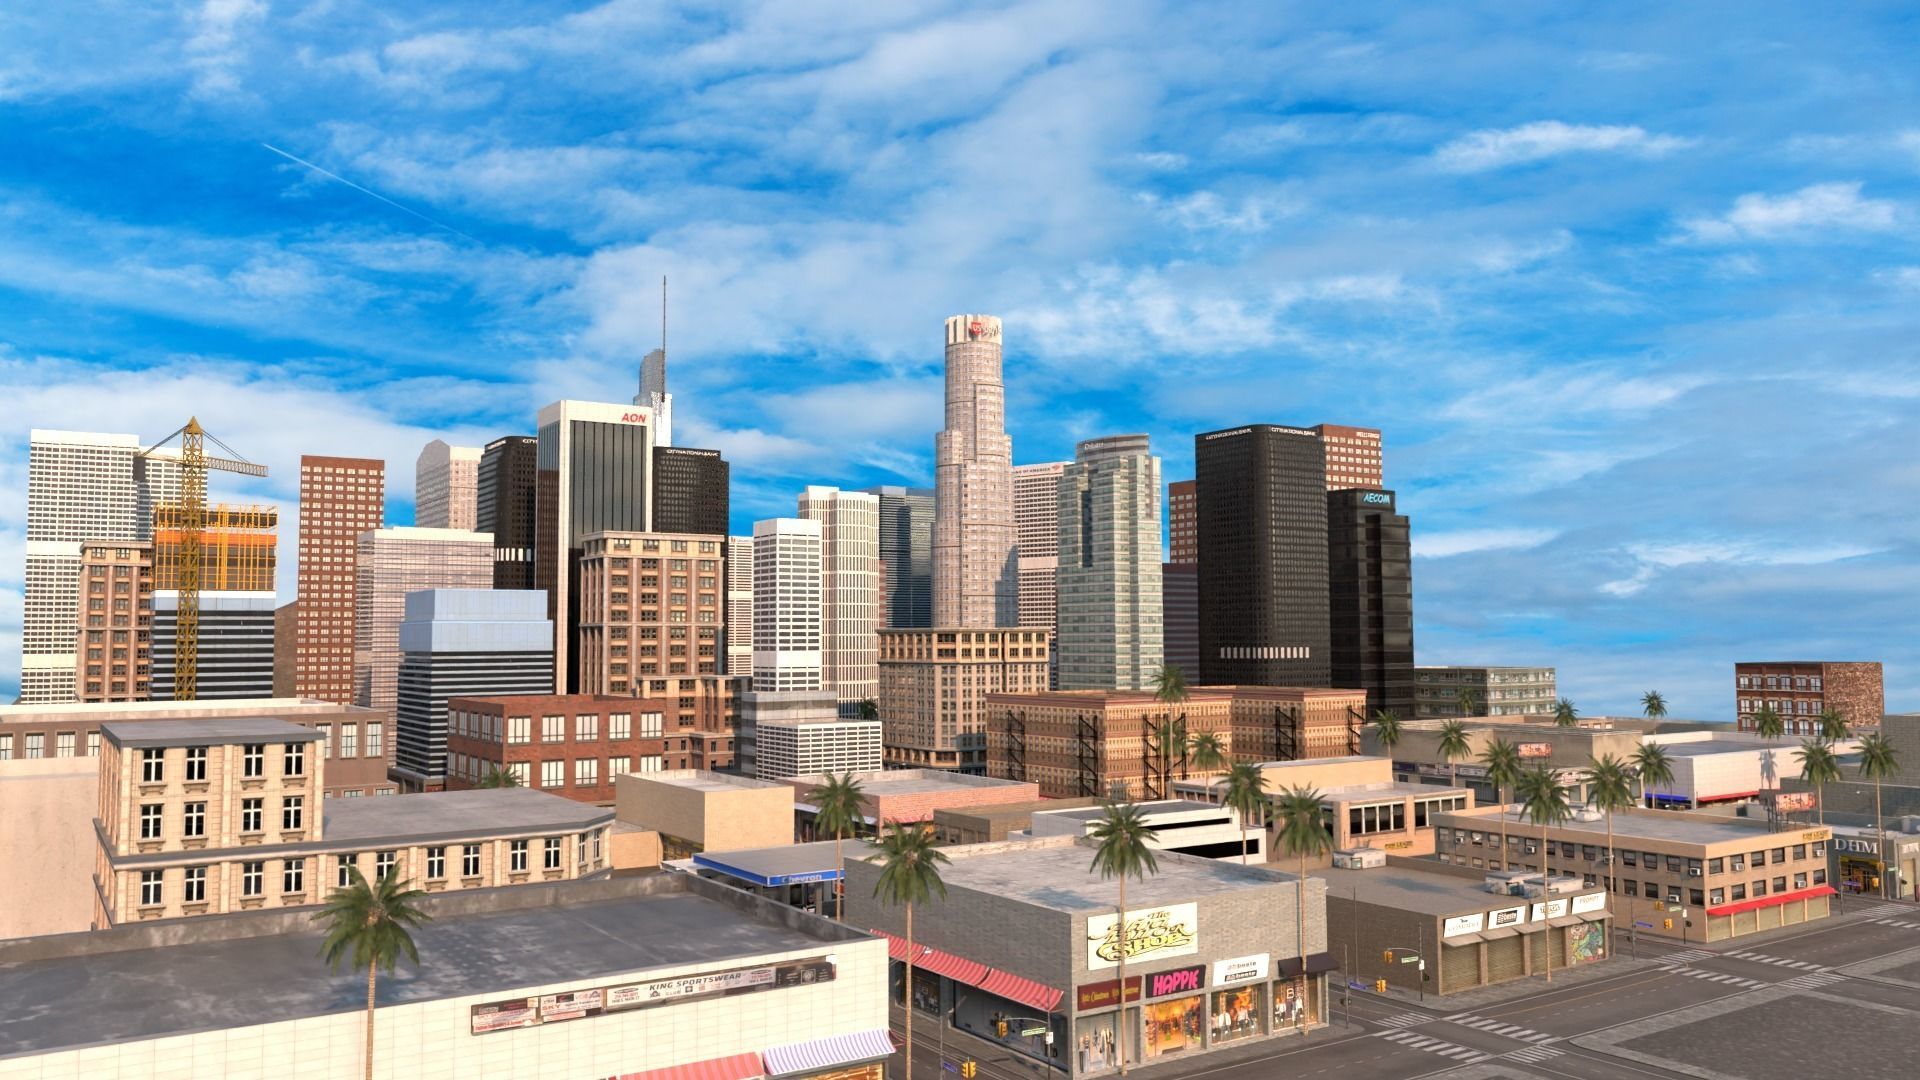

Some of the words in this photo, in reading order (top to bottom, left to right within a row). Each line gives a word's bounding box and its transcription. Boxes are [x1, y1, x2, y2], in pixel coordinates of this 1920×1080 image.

[621, 412, 647, 423] AON
[1363, 492, 1390, 503] AECOM
[1834, 838, 1878, 855] DHM
[1147, 911, 1170, 920] The
[1095, 933, 1184, 961] SHOP
[649, 982, 673, 991] KING
[676, 972, 742, 987] SPORTSWEAR
[1152, 969, 1200, 997] HAPPIE
